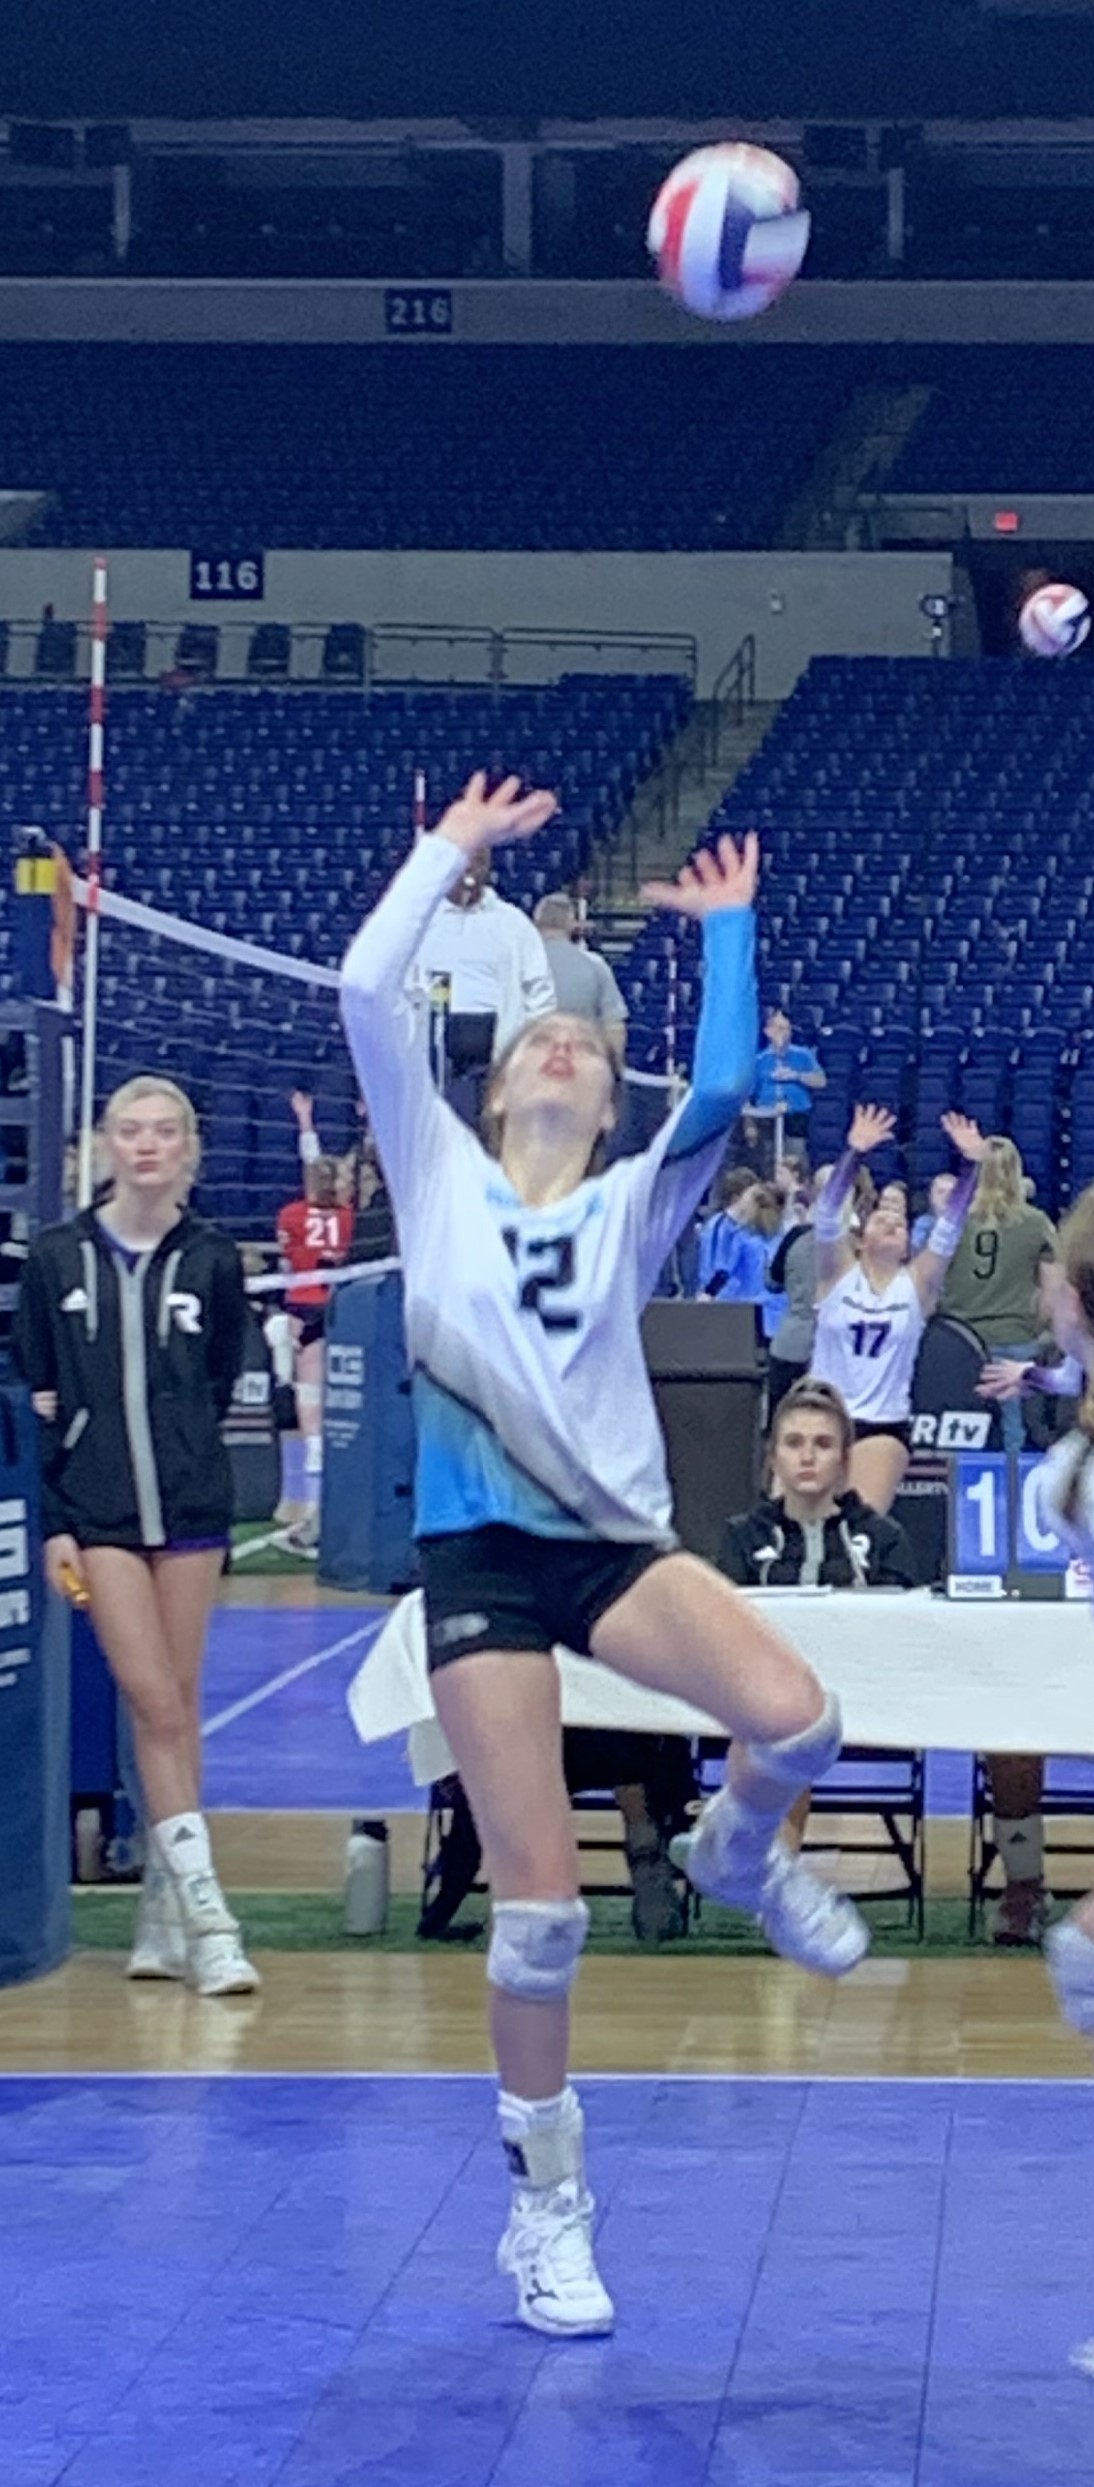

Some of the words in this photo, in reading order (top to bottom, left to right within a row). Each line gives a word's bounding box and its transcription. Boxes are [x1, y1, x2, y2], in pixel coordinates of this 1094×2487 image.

[391, 297, 448, 325] 216
[196, 561, 258, 590] 116
[305, 1217, 339, 1248] 21
[973, 1230, 998, 1279] 9
[166, 1293, 202, 1333] R
[849, 1321, 891, 1358] 17
